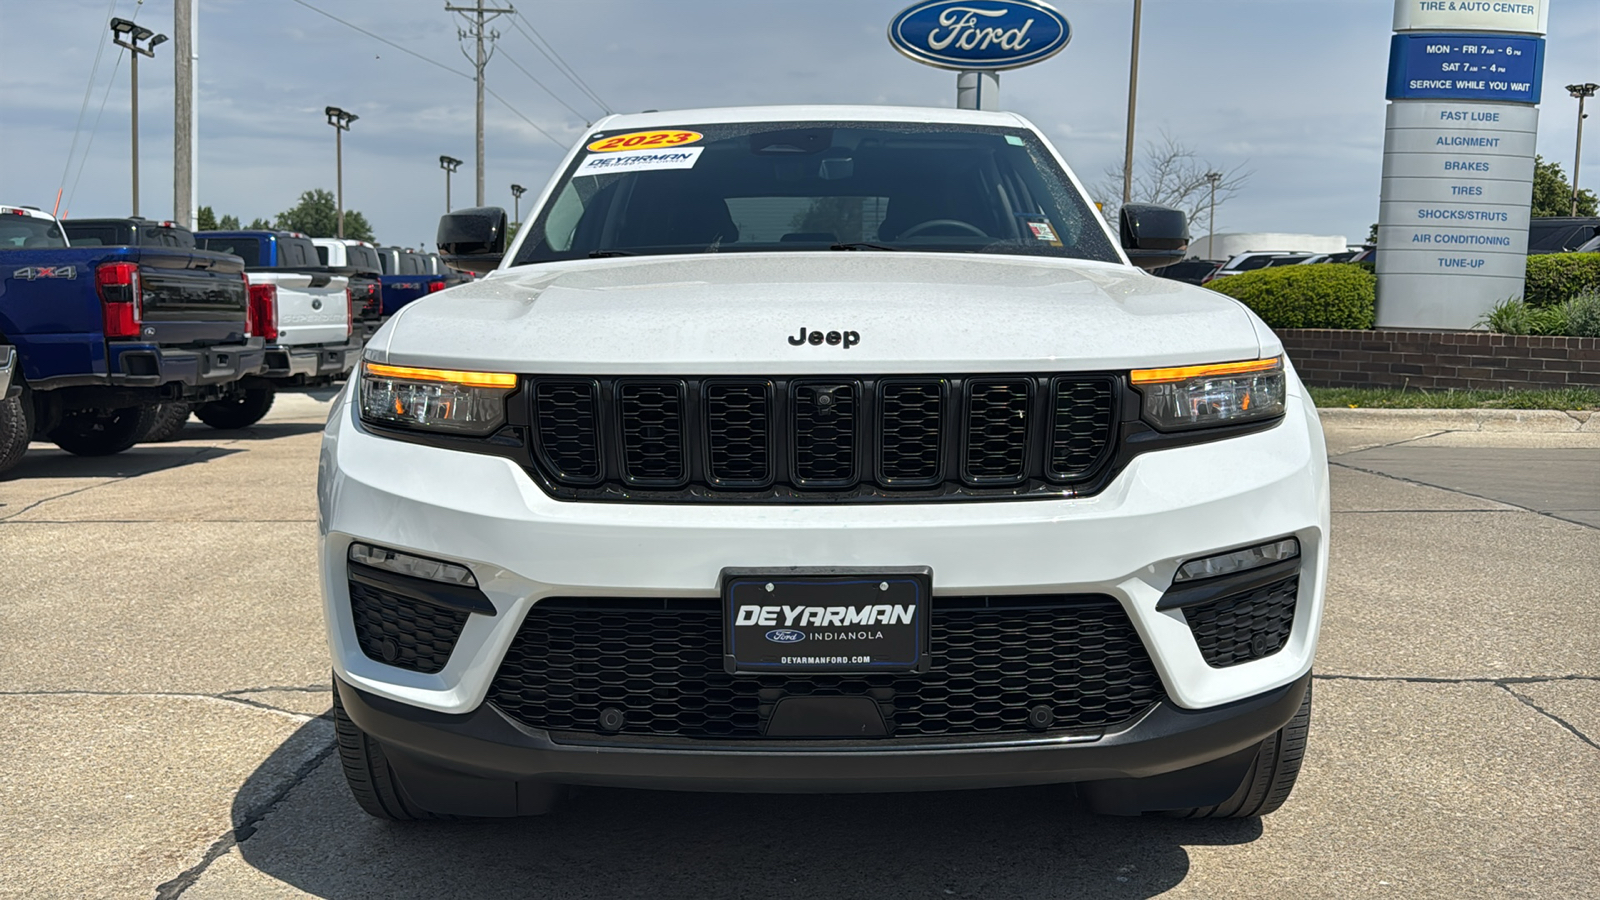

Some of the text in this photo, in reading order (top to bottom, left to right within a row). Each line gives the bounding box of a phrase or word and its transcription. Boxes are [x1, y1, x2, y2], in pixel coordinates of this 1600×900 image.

[1420, 2, 1534, 15] TIRE & AUTO CENTER
[928, 6, 1034, 51] Ford
[1426, 45, 1450, 54] MON
[1463, 45, 1477, 54] FRI
[1442, 63, 1460, 72] SAT
[1410, 80, 1530, 92] SERVICE WHILE YOU WAIT
[1440, 111, 1499, 122] FAST LUBE
[597, 132, 693, 150] 2023
[1436, 137, 1500, 147] ALIGNMENT
[588, 153, 693, 166] DEYARMAN
[1444, 161, 1489, 171] BRAKES
[1451, 186, 1482, 195] TIRES
[1418, 209, 1508, 221] SHOCKS/STRUTS
[1412, 234, 1510, 246] AIR CONDITIONING
[1438, 258, 1484, 268] TUNE-UP
[788, 327, 860, 349] Jeep
[735, 605, 916, 626] DEYARMAN
[773, 630, 883, 640] Ford INDIANOLA
